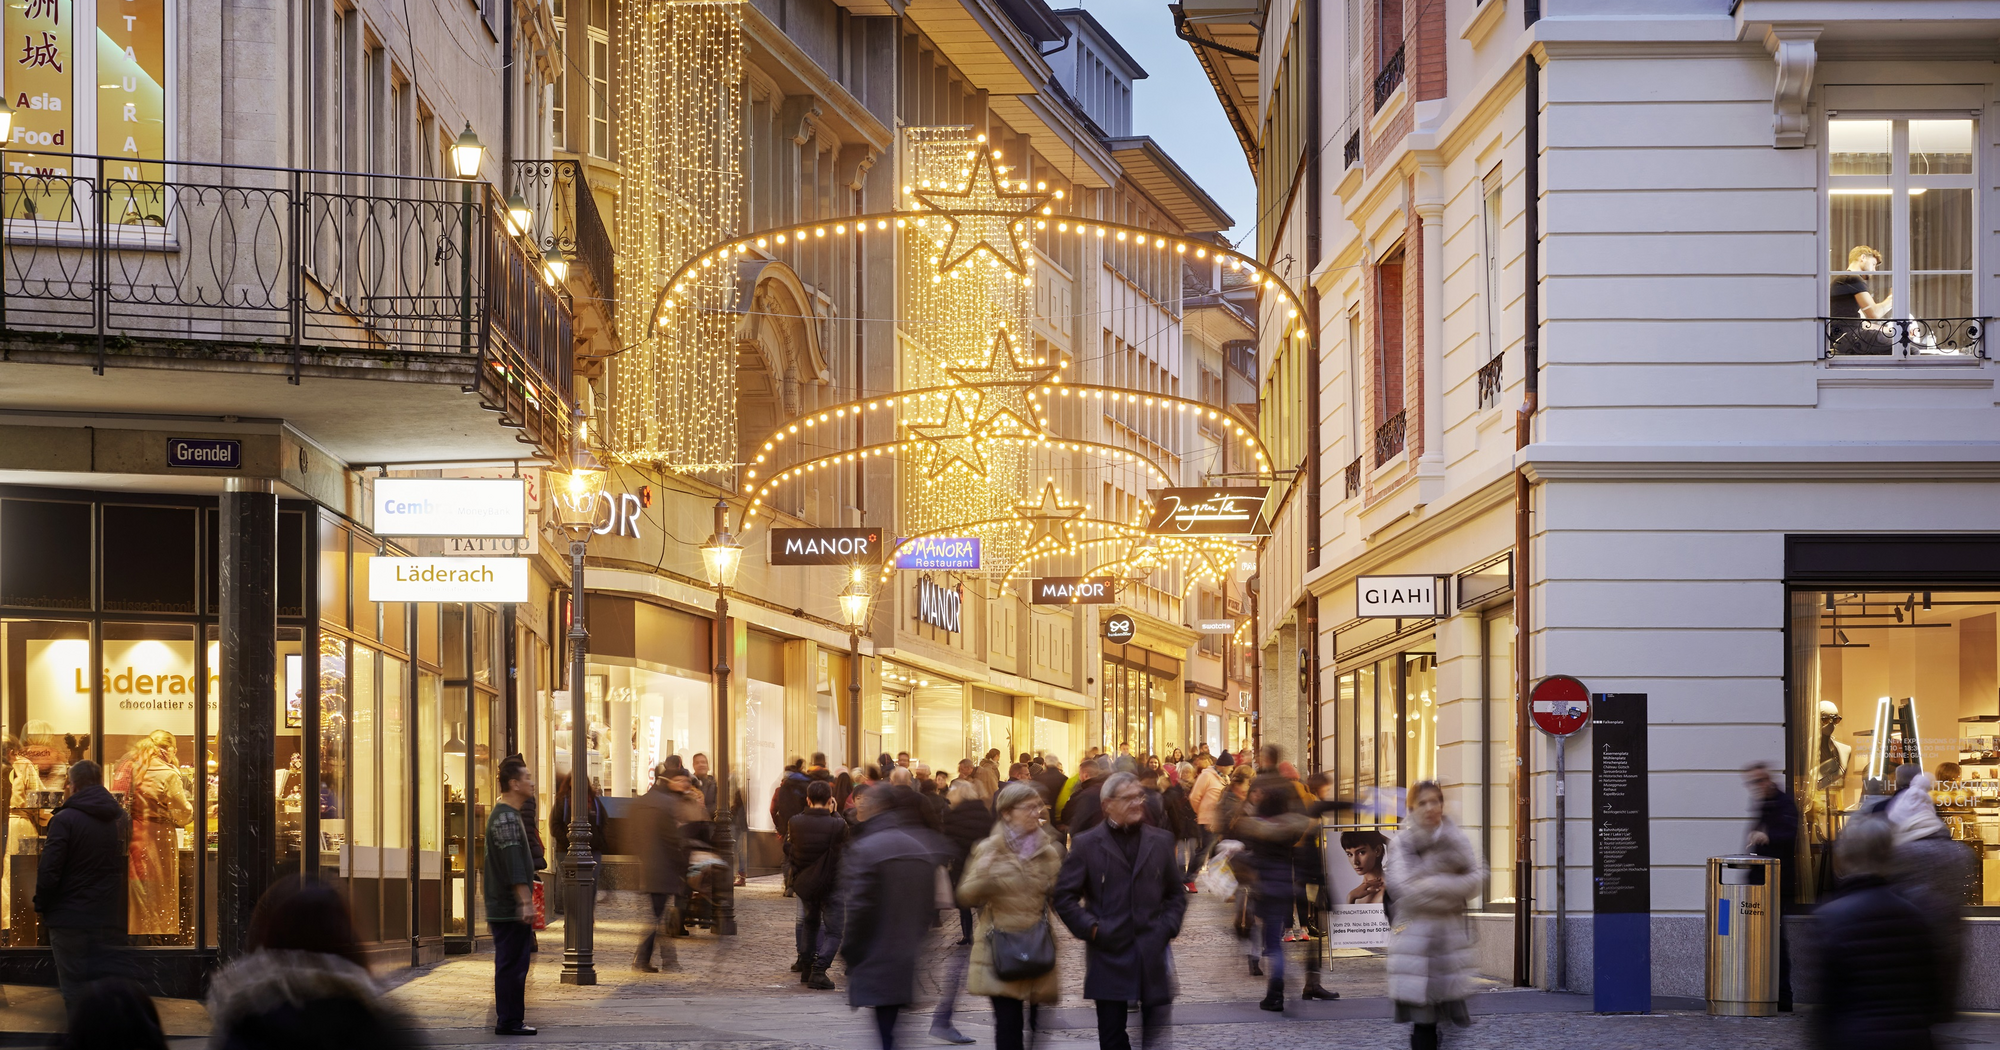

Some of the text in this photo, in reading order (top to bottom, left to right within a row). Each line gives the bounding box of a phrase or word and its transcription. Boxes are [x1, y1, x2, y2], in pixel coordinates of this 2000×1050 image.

[16, 92, 62, 111] Asia
[13, 126, 65, 146] Food
[9, 161, 68, 180] Town
[177, 442, 232, 462] Grendel
[450, 538, 531, 552] TATTOO
[785, 537, 868, 555] MANOR
[915, 540, 973, 560] MANORA
[916, 558, 974, 568] Restaurant
[396, 564, 495, 583] Läderach
[1042, 583, 1104, 597] MANOR
[1365, 588, 1430, 604] GIAHI
[920, 578, 961, 634] MANOR
[119, 698, 185, 710] chocolatier
[1936, 795, 1982, 807] 50 CHF
[1740, 901, 1761, 909] Stadt
[1740, 908, 1765, 916] Luzern
